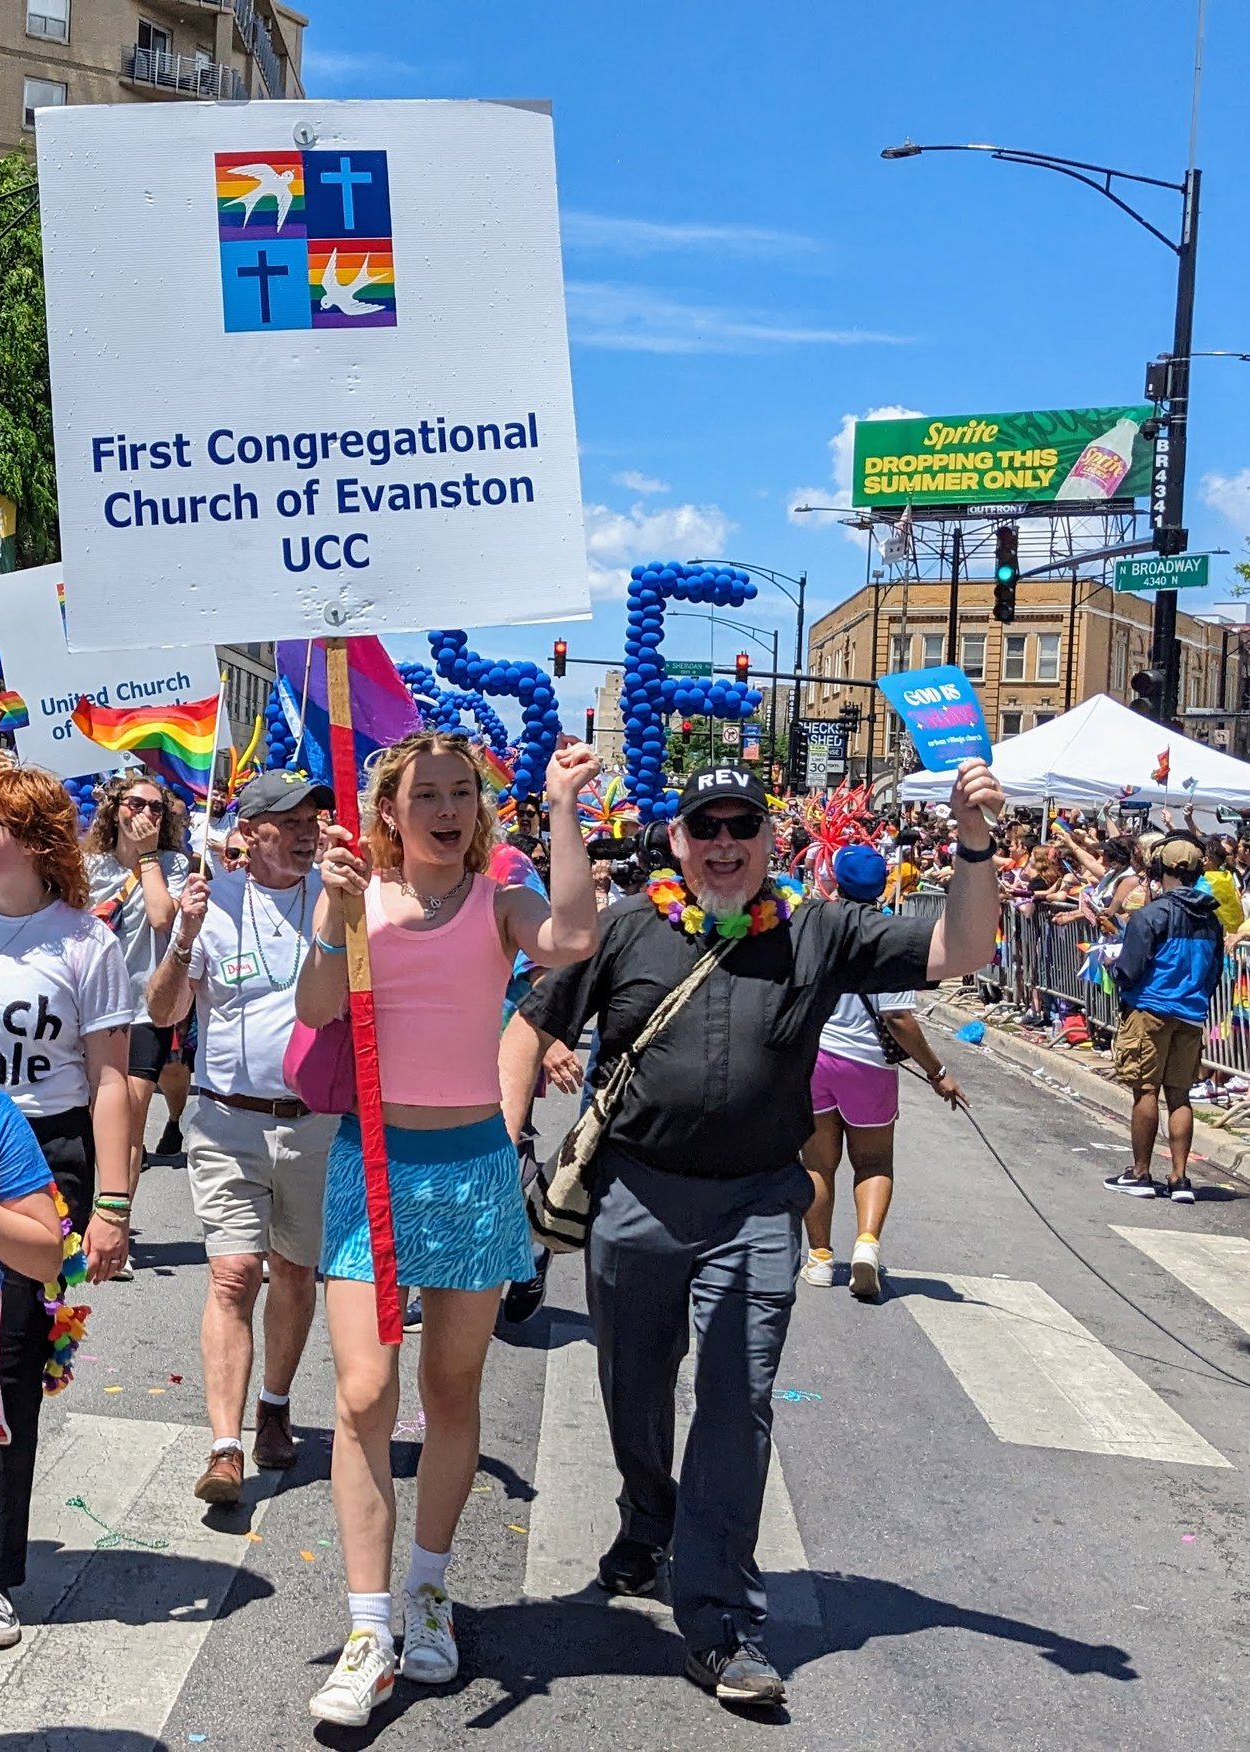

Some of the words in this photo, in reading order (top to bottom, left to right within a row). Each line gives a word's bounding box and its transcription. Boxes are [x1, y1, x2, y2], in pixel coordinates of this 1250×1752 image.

[91, 432, 191, 474] First
[207, 411, 540, 470] Congregational
[923, 419, 999, 450] Sprite
[864, 451, 994, 475] DROPPING
[996, 448, 1059, 468] THIS
[863, 471, 979, 495] SUMMER
[983, 468, 1057, 489] ONLY
[1153, 439, 1170, 528] BR4341
[104, 482, 258, 529] Church
[276, 477, 320, 518] of
[336, 471, 535, 515] Evanston
[969, 504, 1024, 514] OUTFRONT
[282, 532, 371, 573] UCC
[1119, 565, 1127, 575] N
[1131, 558, 1202, 576] BROADWAY
[1143, 576, 1167, 586] 4340
[1171, 575, 1179, 585] N
[116, 671, 191, 701] Church
[904, 687, 942, 705] GOD
[939, 684, 961, 700] IS
[52, 719, 73, 740] of
[698, 769, 749, 791] REV
[809, 762, 826, 773] 30
